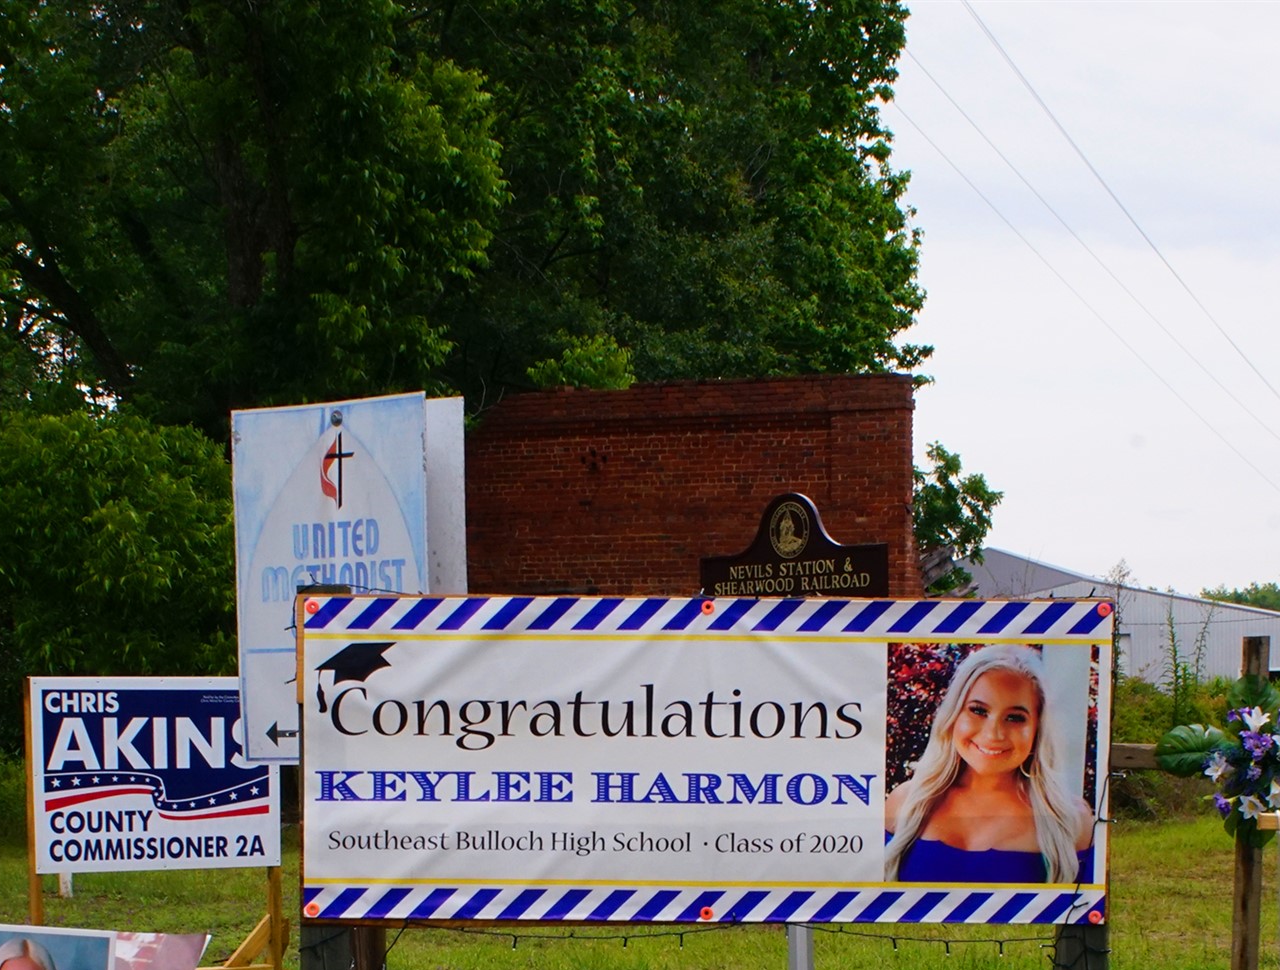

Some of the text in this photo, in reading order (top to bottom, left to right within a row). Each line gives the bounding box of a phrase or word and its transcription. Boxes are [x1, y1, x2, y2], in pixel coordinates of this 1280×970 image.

[292, 518, 380, 560] UNITED
[261, 558, 406, 602] METHODIST
[729, 556, 853, 580] NEVILS STATION &
[714, 572, 870, 596] SHEARWOOD RAILROAD
[44, 691, 119, 713] CHRIS
[330, 683, 863, 750] Congratulations
[314, 770, 877, 806] KEYLEE HARMON
[50, 810, 153, 834] COUNTY
[49, 835, 266, 862] COMMISSIONER 2A
[328, 829, 864, 857] Southeast Bulloch High School Class of 2020
